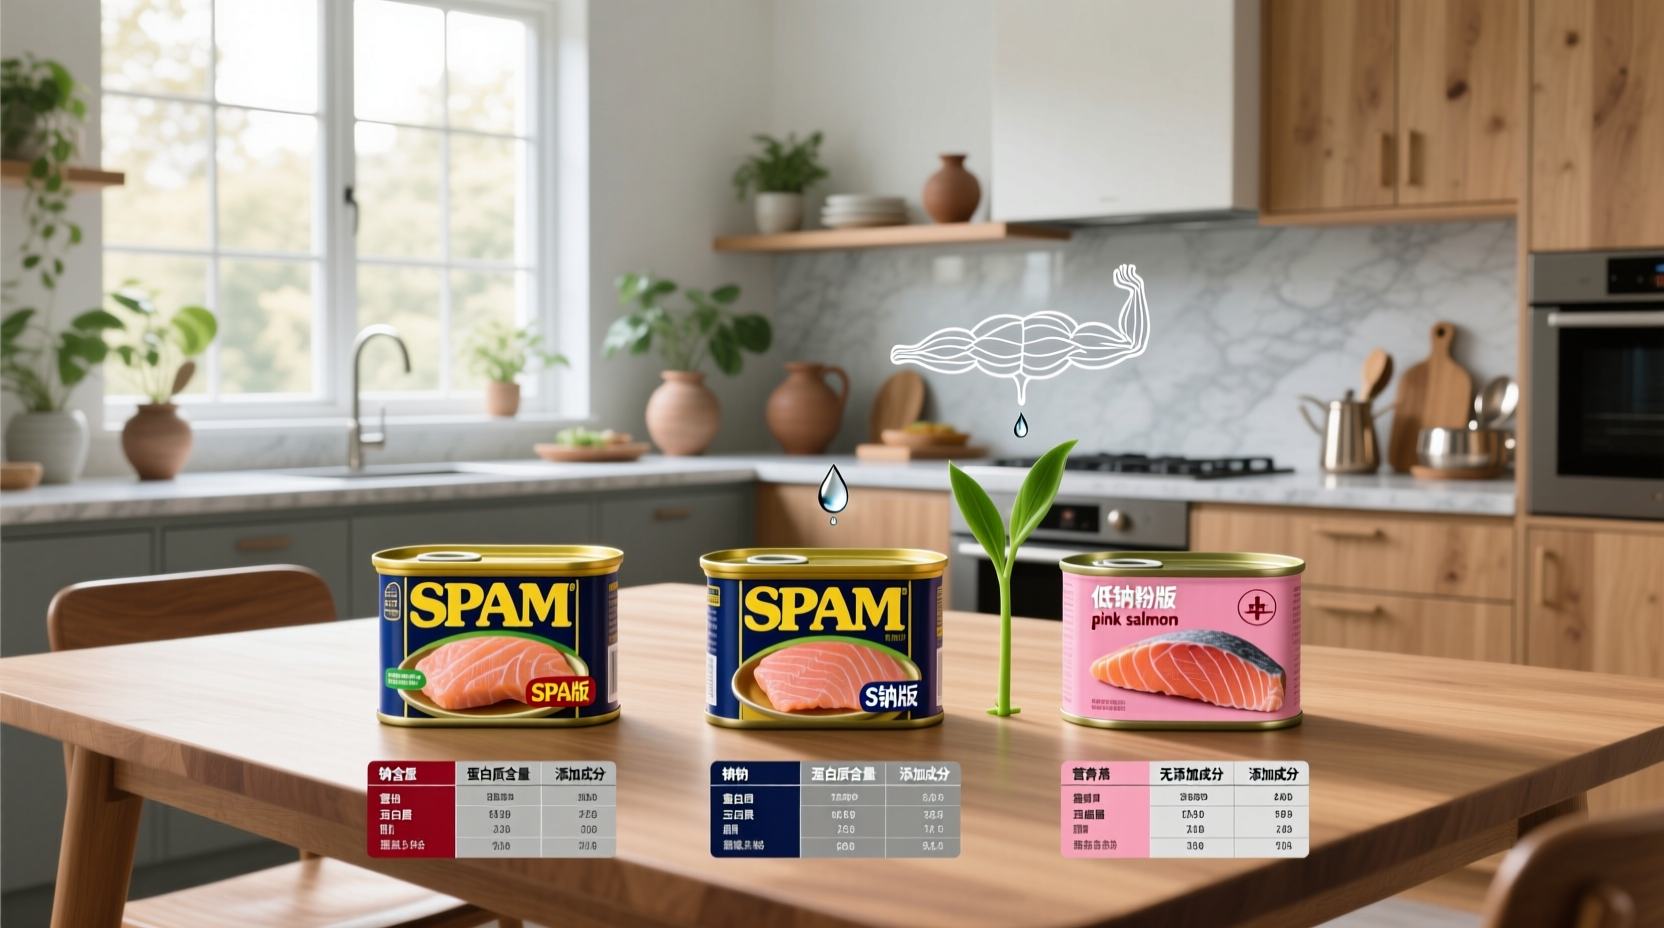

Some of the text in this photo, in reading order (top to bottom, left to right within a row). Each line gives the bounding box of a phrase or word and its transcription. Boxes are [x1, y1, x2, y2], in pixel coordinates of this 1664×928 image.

[410, 582, 572, 628] SPAM
[744, 586, 905, 632] SPAM
[1092, 611, 1178, 630] pink salmon
